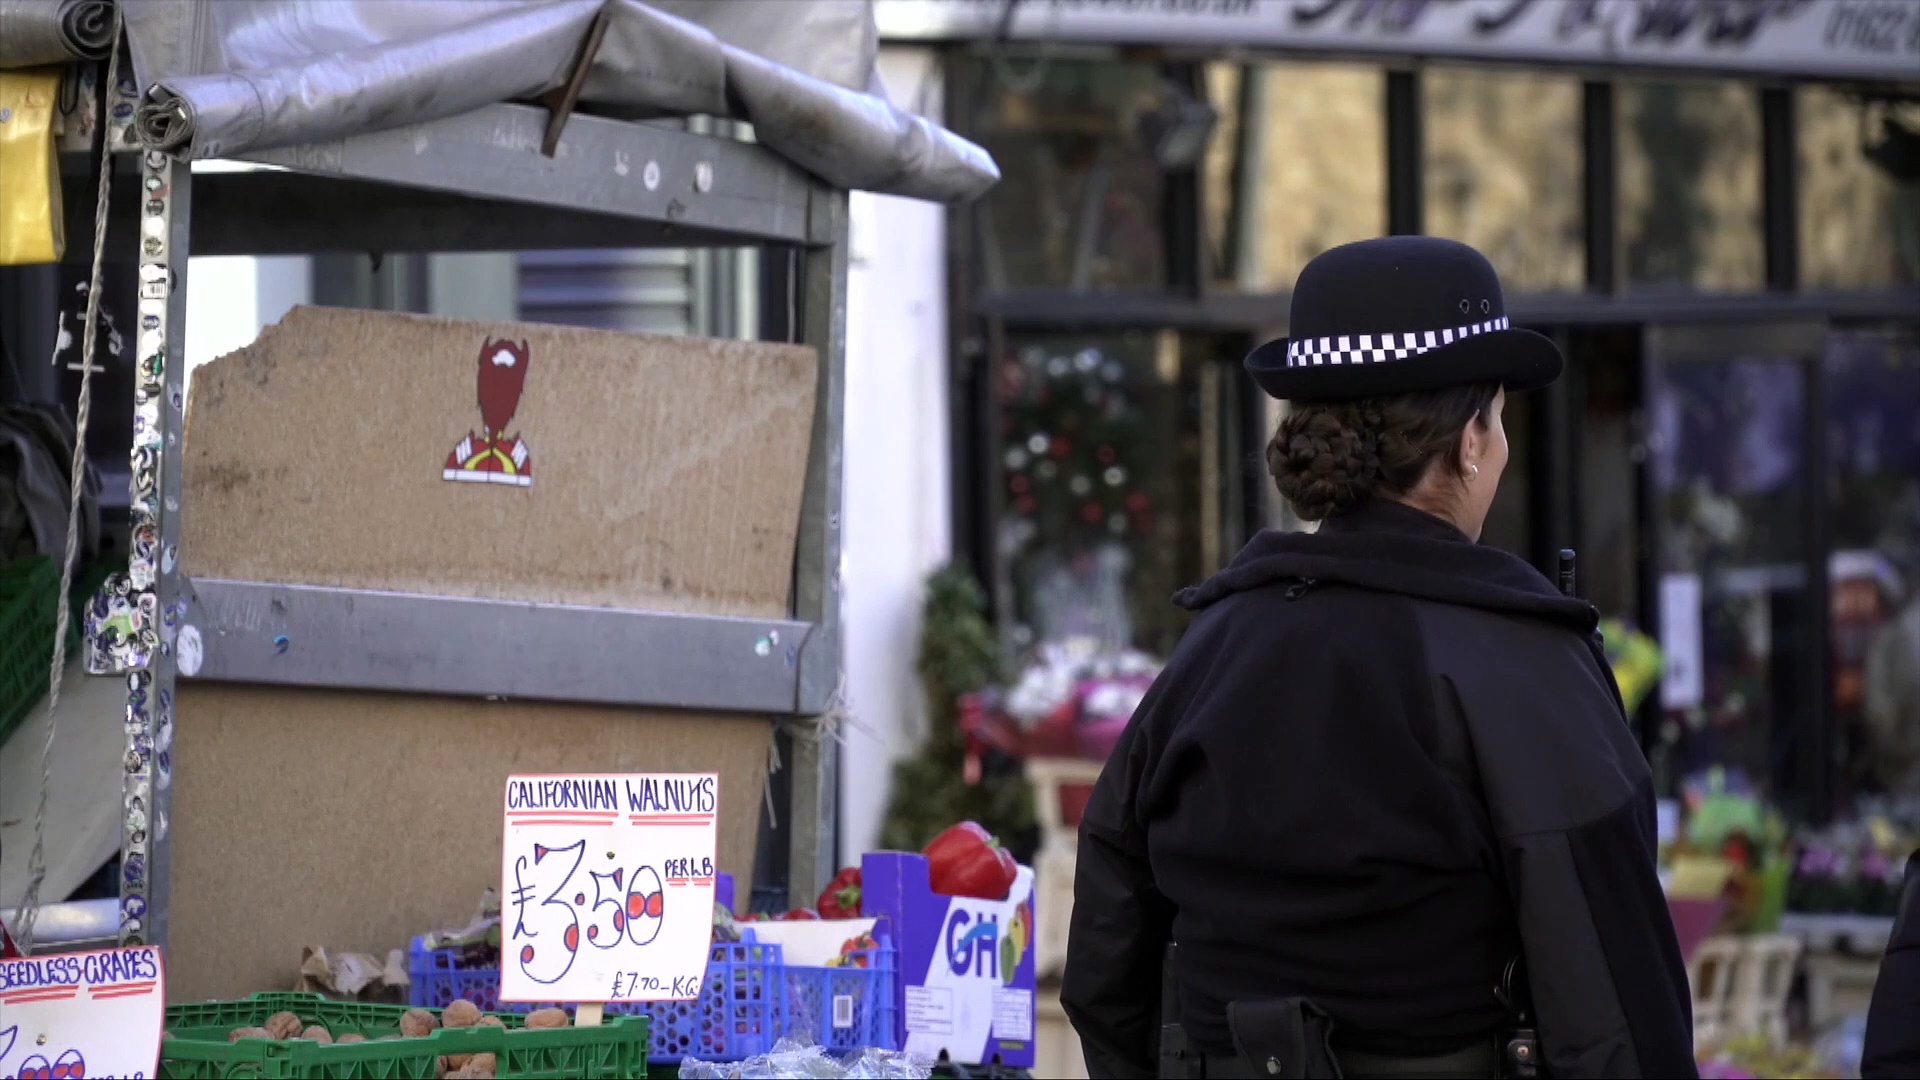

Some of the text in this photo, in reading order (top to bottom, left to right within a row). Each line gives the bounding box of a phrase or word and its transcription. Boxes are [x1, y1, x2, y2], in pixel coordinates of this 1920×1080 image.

[508, 777, 715, 812] CALIFORNIAN WALNUTS
[665, 857, 713, 877] PER LB
[511, 839, 663, 983] £3.50
[85, 949, 157, 984] GRAPES
